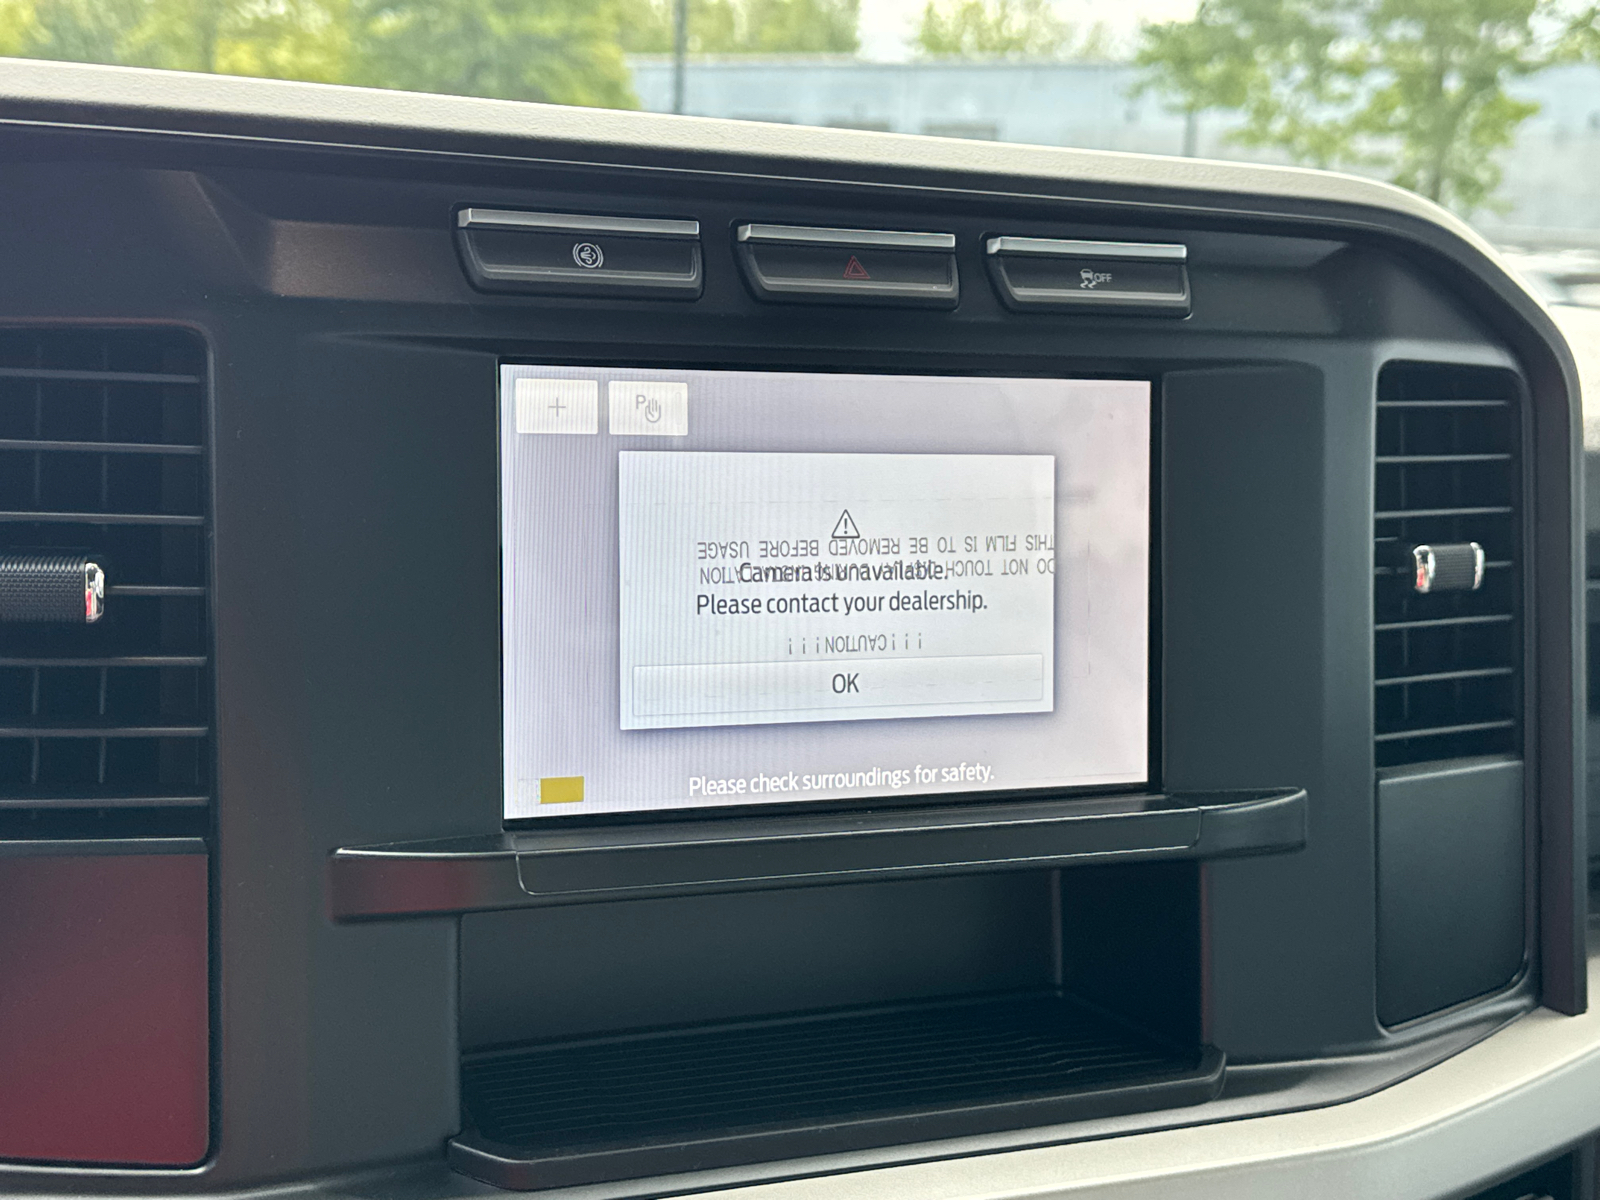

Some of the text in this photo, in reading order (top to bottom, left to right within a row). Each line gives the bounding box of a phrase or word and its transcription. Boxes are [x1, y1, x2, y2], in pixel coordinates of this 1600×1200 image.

[1094, 273, 1112, 283] OFF
[697, 534, 1054, 560] THIS FILM IS TO BE REMOVED BEFORE USAGE
[740, 562, 812, 583] Camera
[836, 560, 949, 582] unavailable.
[945, 559, 994, 577] TOUCH
[1000, 558, 1028, 576] NOT
[1036, 557, 1054, 575] DO
[696, 590, 988, 616] Please contact your dealership.
[831, 672, 860, 694] OK
[689, 762, 995, 797] Please check surroundings for safety.
